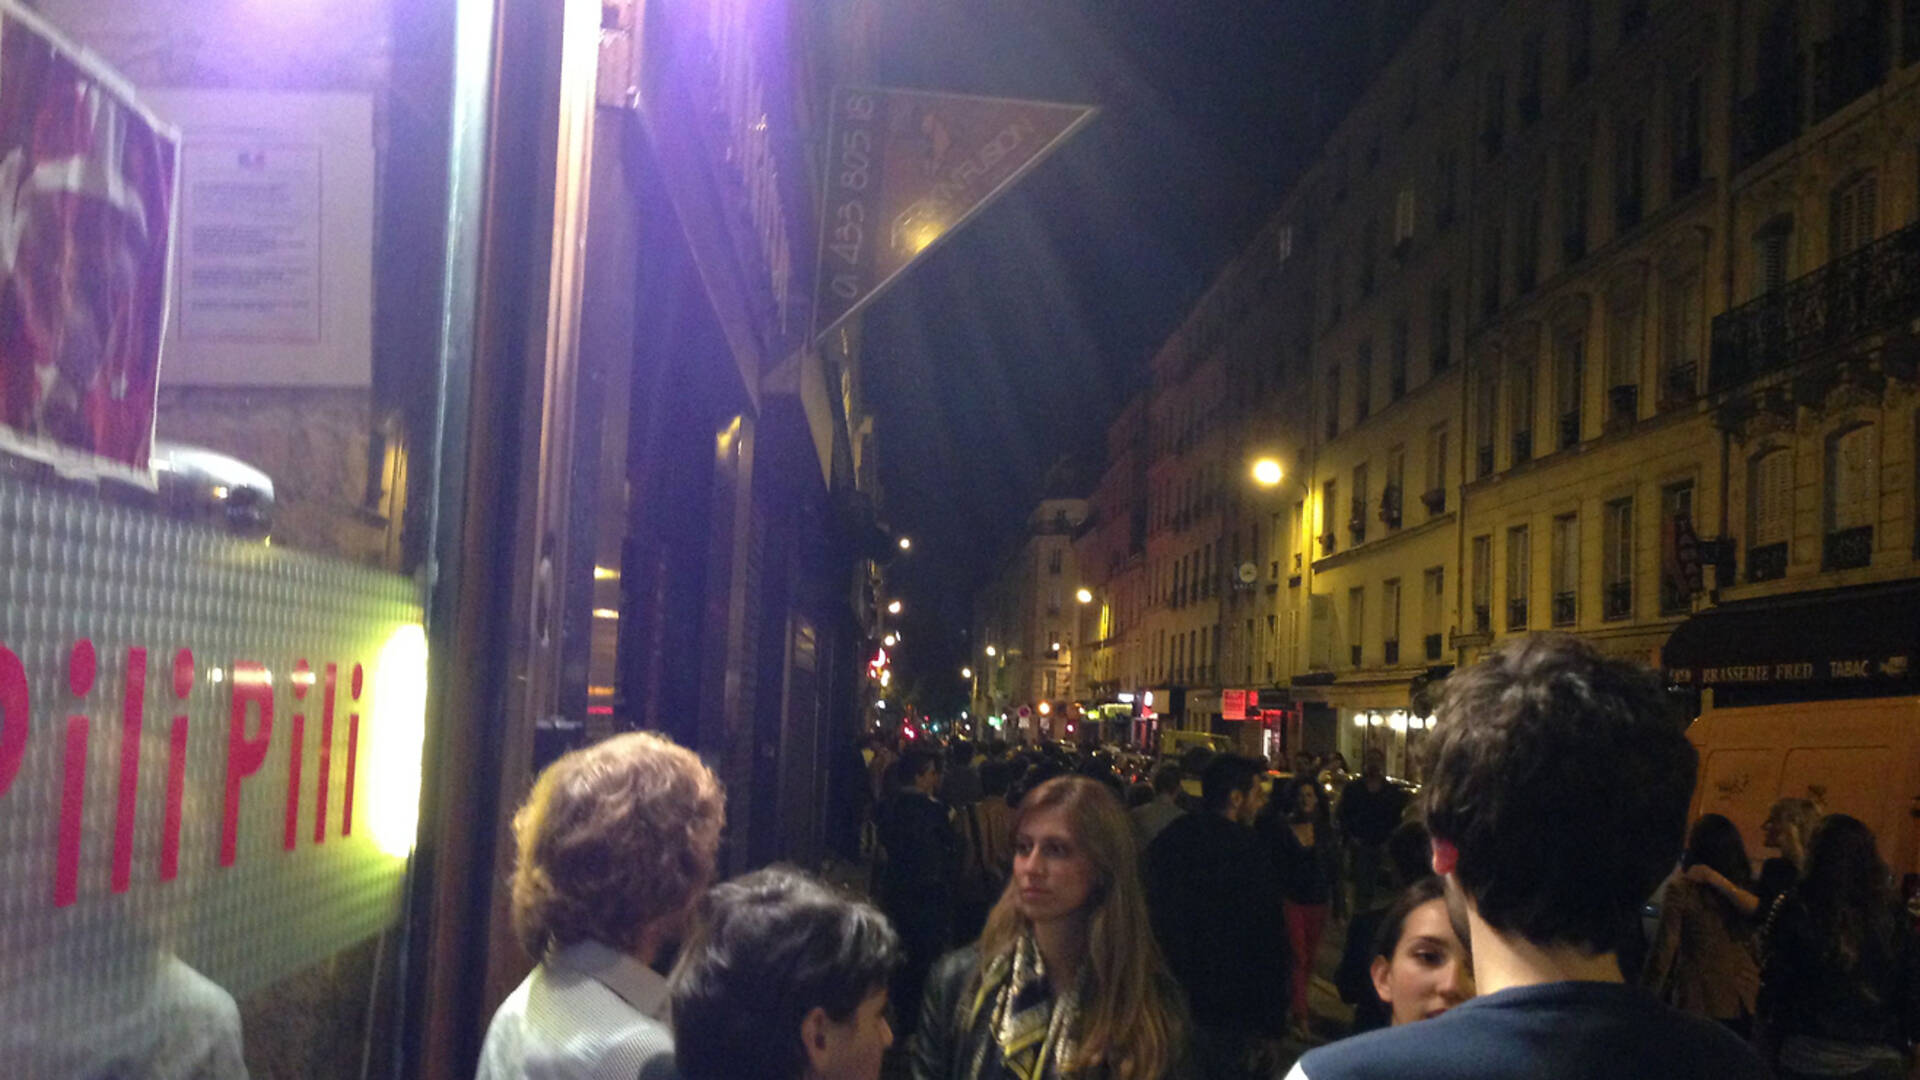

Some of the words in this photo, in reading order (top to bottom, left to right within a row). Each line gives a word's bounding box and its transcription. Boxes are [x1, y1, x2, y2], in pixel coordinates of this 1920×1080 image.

[1702, 665, 1769, 683] BRASSERIE
[1775, 662, 1813, 680] FRED
[1829, 660, 1869, 678] TABAC
[220, 658, 363, 867] Pili
